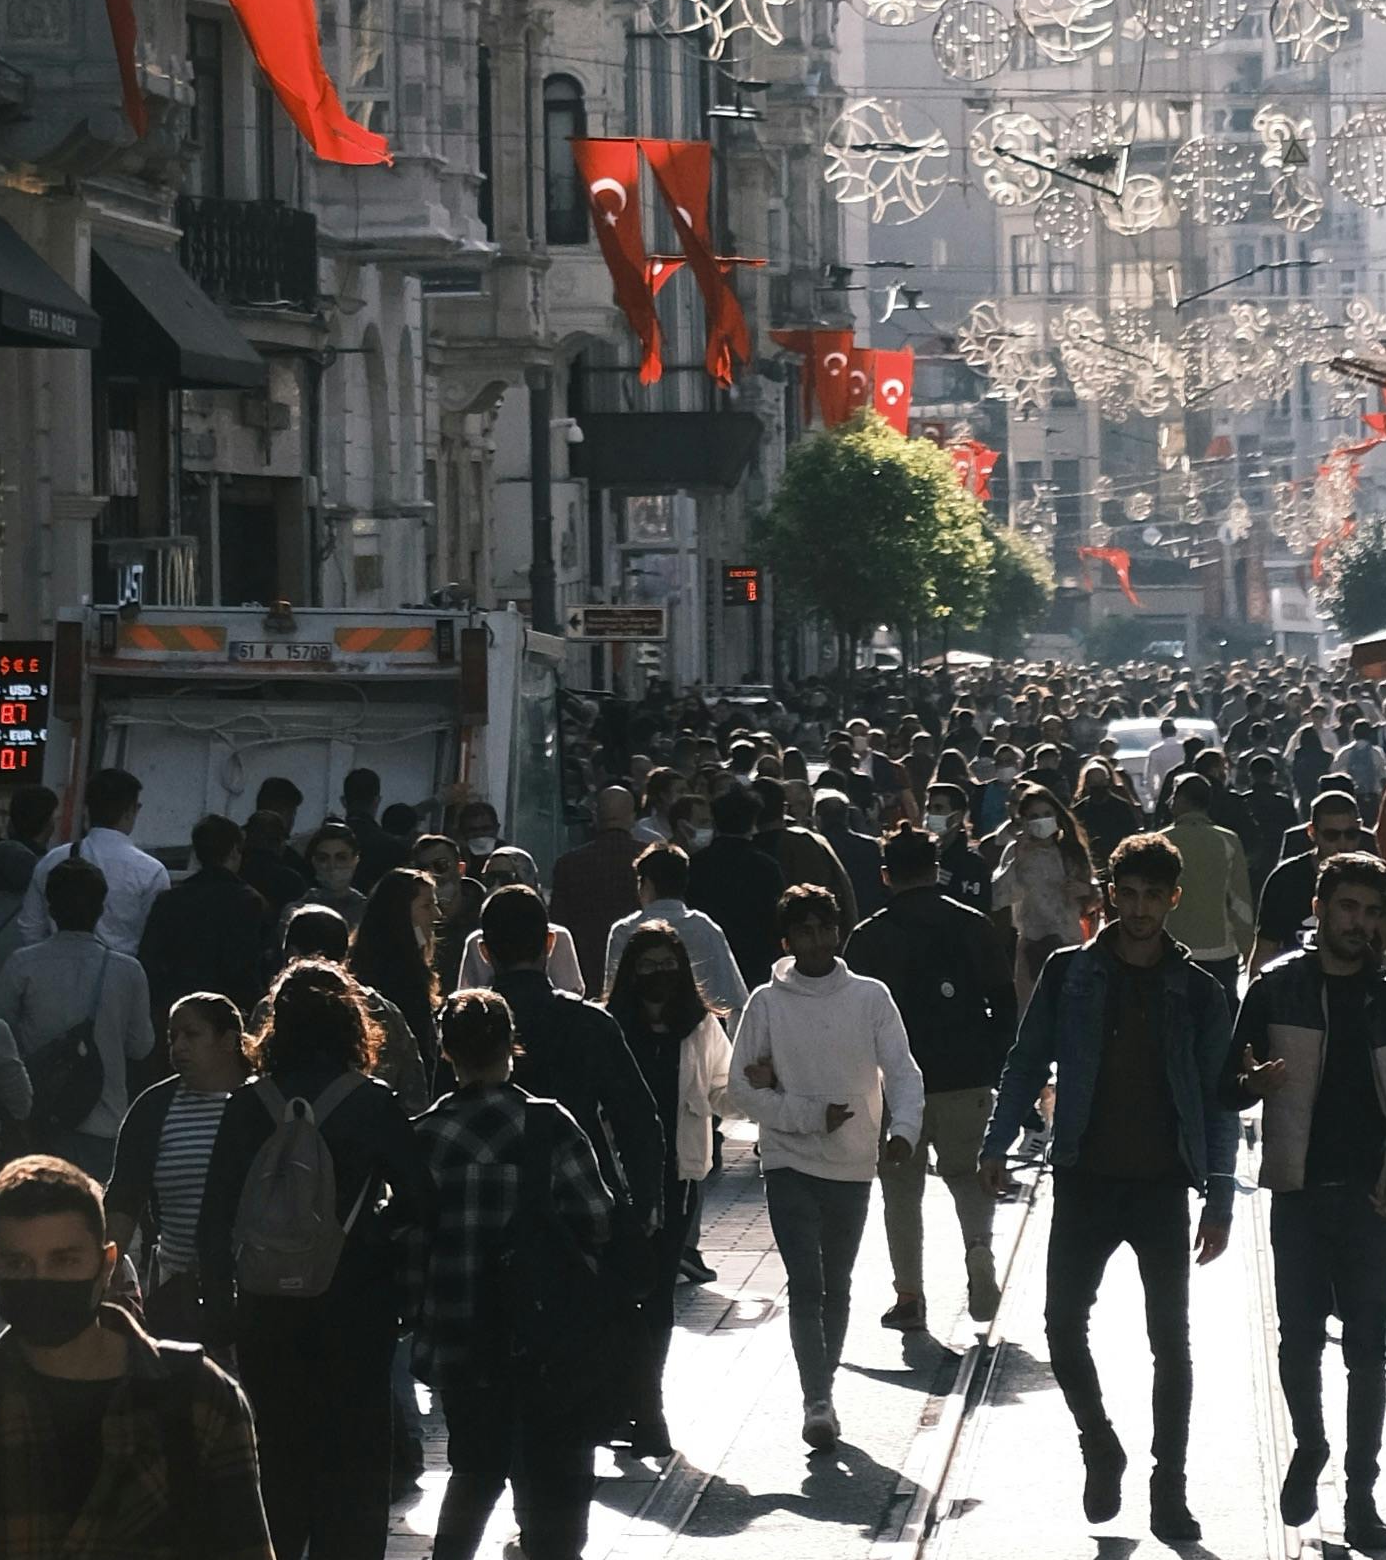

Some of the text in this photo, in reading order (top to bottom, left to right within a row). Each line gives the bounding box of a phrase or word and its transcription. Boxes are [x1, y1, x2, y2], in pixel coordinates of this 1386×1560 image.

[28, 308, 49, 329] PERA
[9, 684, 32, 695] USD
[9, 729, 32, 741] EUR
